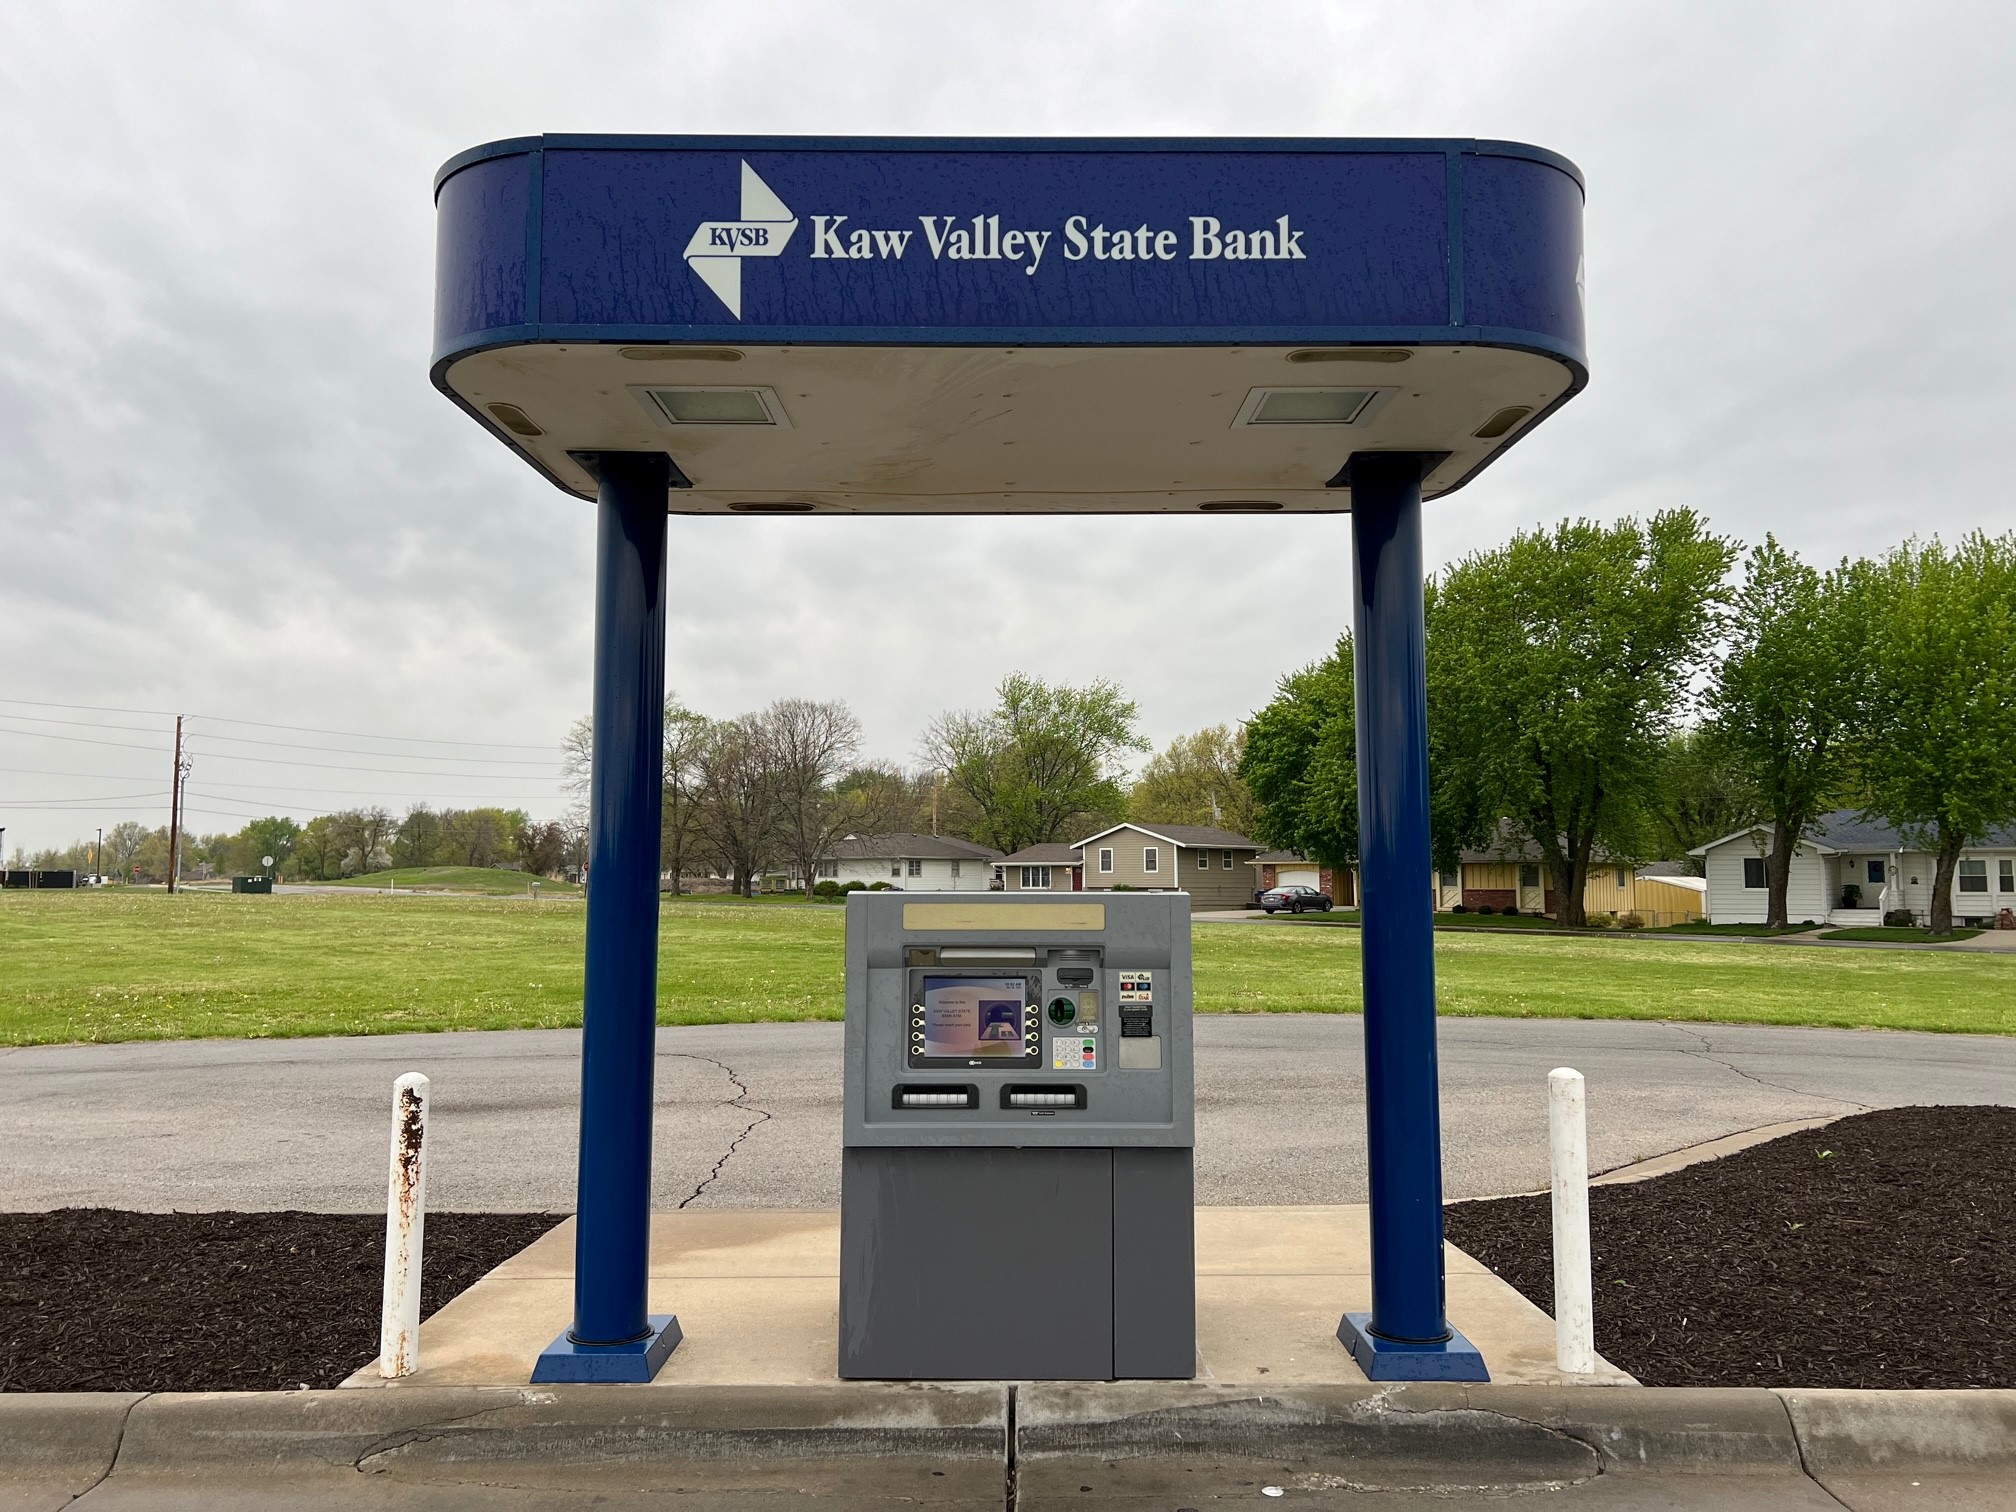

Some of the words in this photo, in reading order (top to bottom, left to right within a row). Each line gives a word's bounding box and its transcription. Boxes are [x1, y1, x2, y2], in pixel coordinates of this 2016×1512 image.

[709, 227, 769, 253] KVSB
[810, 215, 912, 260] Kaw
[918, 214, 1052, 276] Valley
[1064, 215, 1178, 260] State
[1188, 214, 1307, 260] Bank
